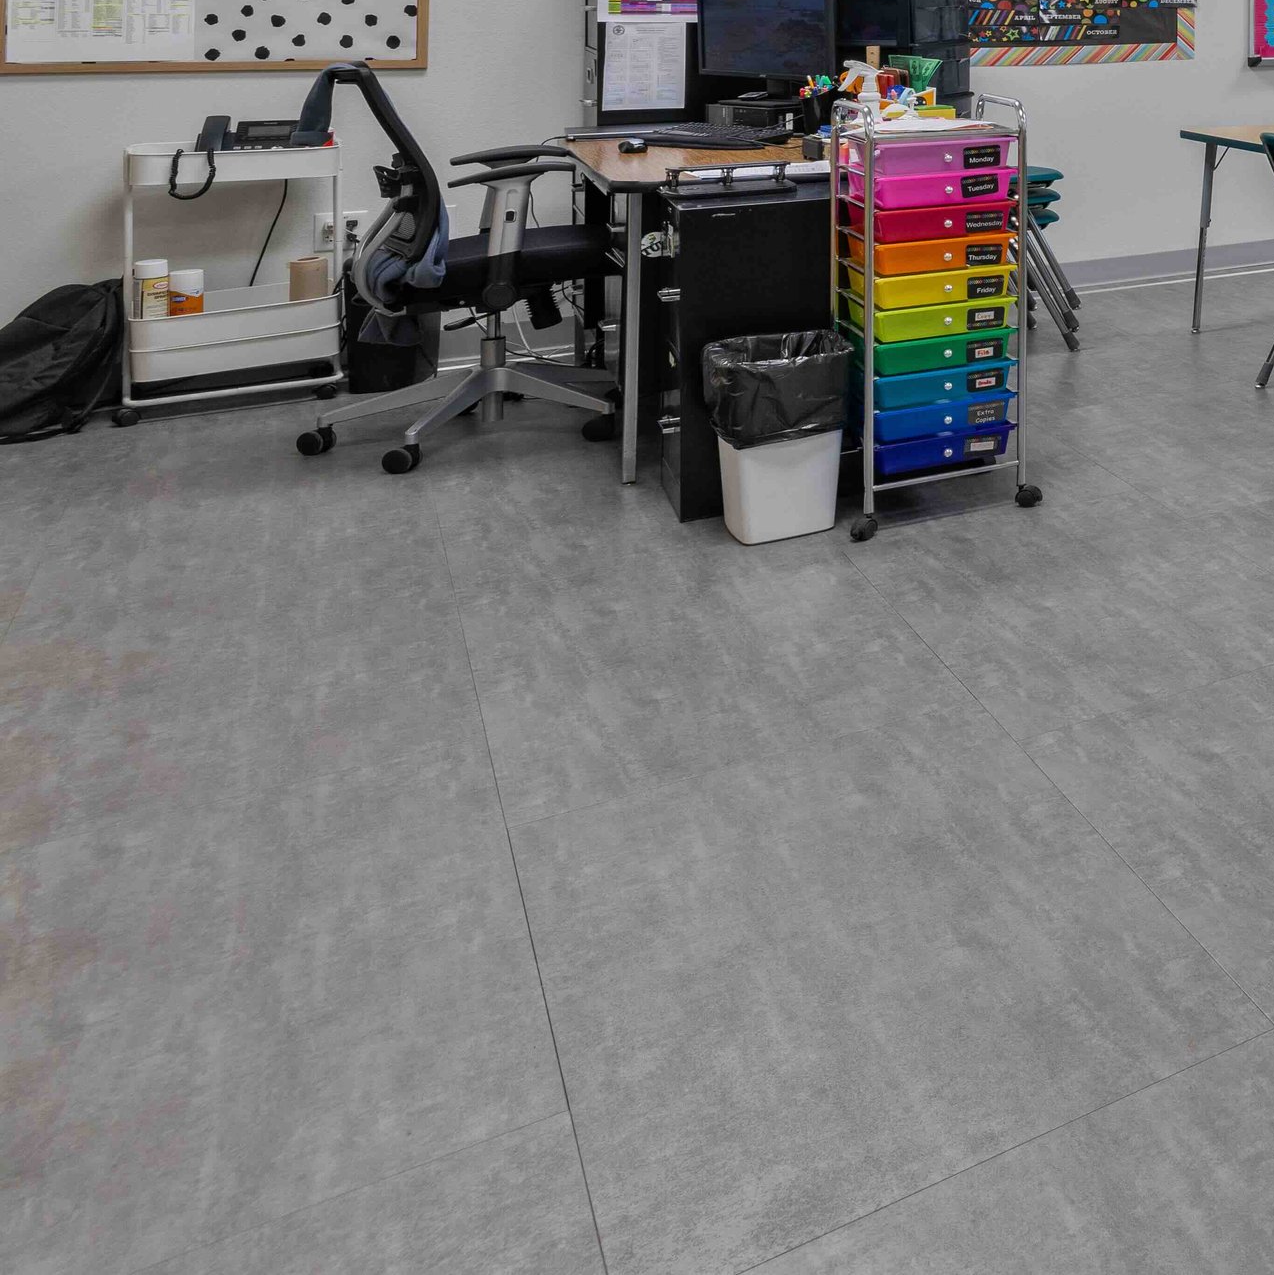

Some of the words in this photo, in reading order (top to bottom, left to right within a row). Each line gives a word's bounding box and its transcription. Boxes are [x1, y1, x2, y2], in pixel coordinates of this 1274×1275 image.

[969, 156, 994, 164] Monday
[968, 183, 994, 192] Tuesday
[966, 220, 1002, 228] Wednesday
